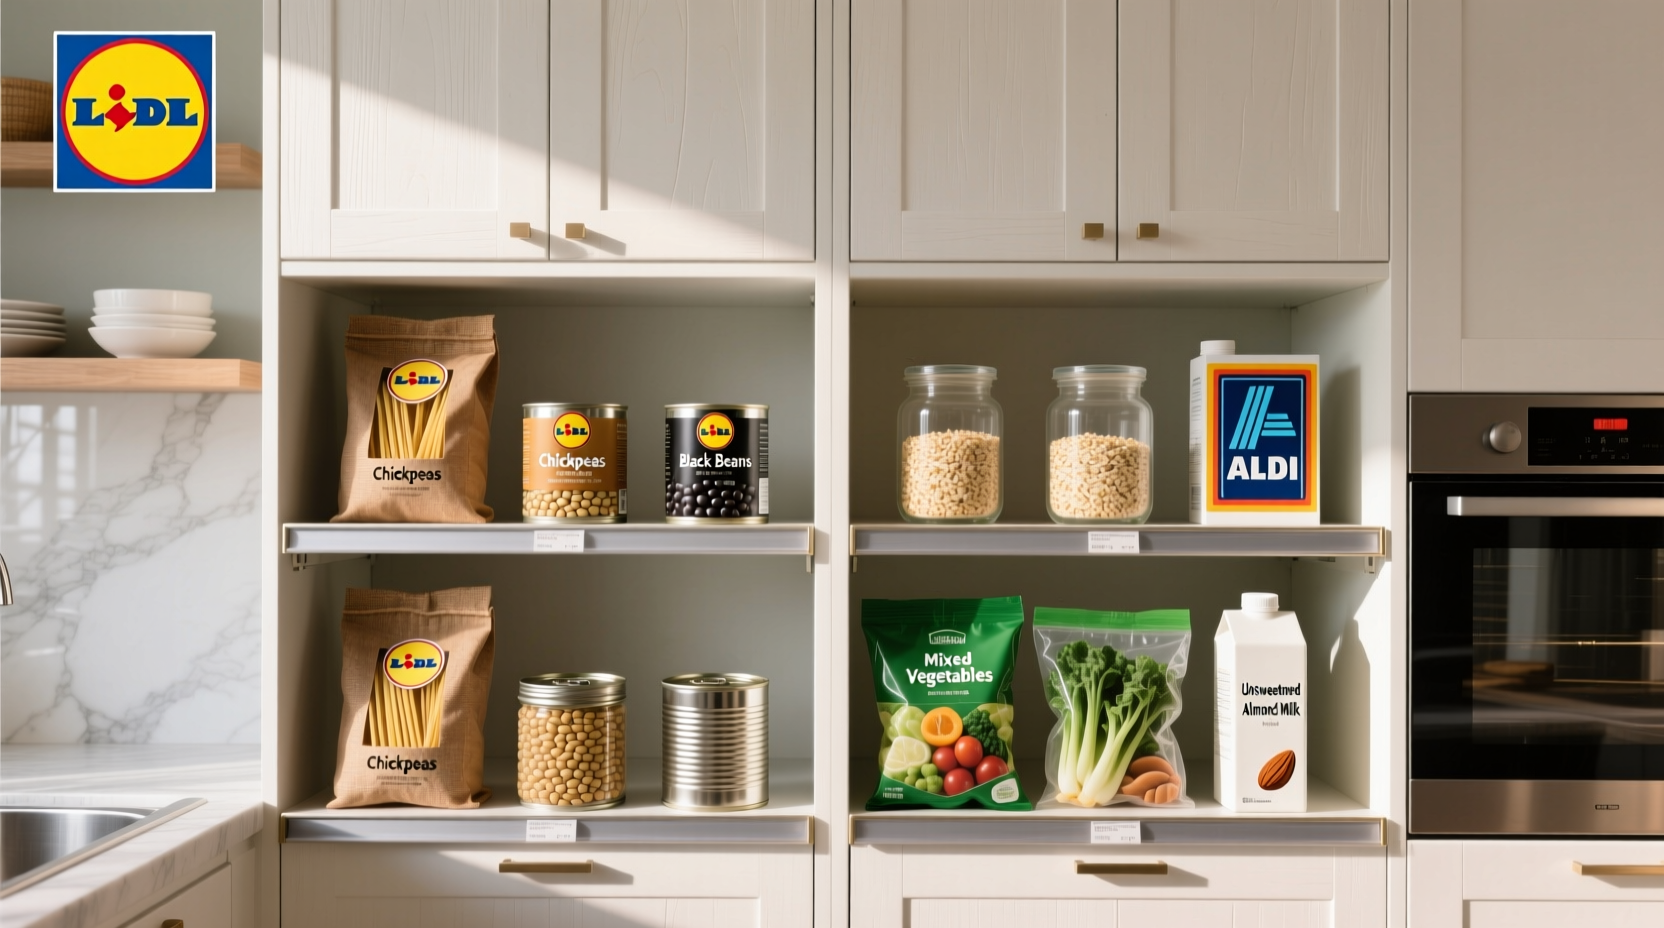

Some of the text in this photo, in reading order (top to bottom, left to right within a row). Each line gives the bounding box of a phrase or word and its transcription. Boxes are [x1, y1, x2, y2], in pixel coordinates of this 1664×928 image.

[538, 452, 606, 471] Chickpeas
[679, 451, 752, 468] Black Beans
[1226, 455, 1298, 481] ALDI
[924, 651, 972, 668] Mixed
[905, 666, 993, 688] Vegetables
[367, 754, 438, 775] Chickpeas
